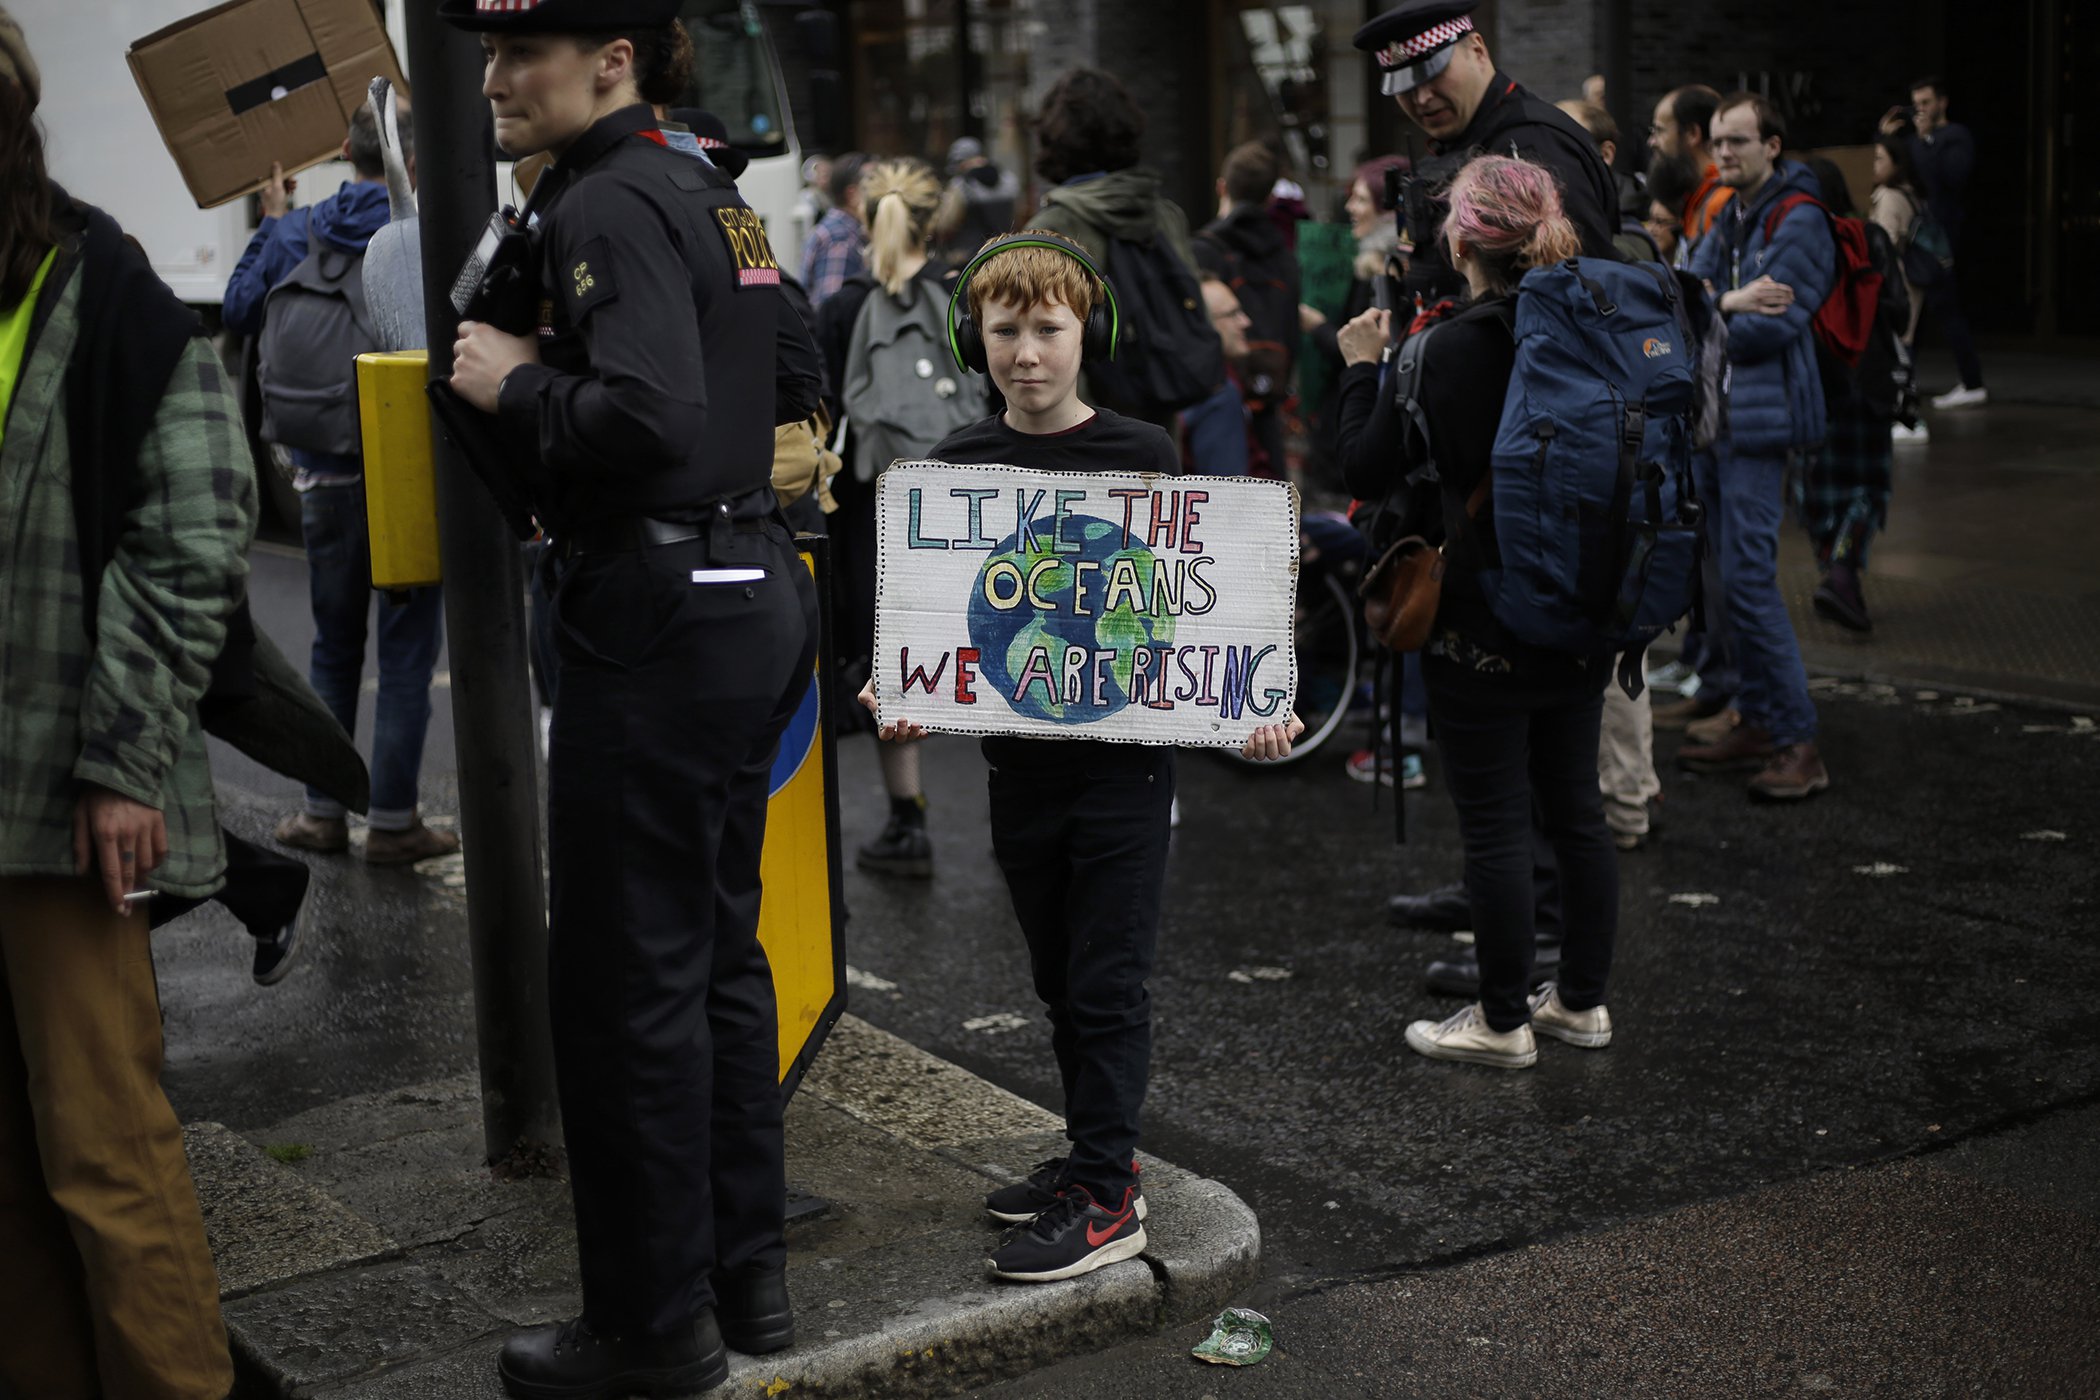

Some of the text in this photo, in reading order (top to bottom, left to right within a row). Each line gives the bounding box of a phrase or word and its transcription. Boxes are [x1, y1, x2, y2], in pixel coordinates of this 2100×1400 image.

[718, 207, 742, 227] CITY
[726, 227, 778, 269] POLIC
[574, 262, 587, 280] CP
[576, 274, 594, 296] 656
[908, 488, 1209, 554] LIKE THE
[984, 556, 1217, 616] OCEANS
[900, 644, 1287, 720] WE ARE RISING
